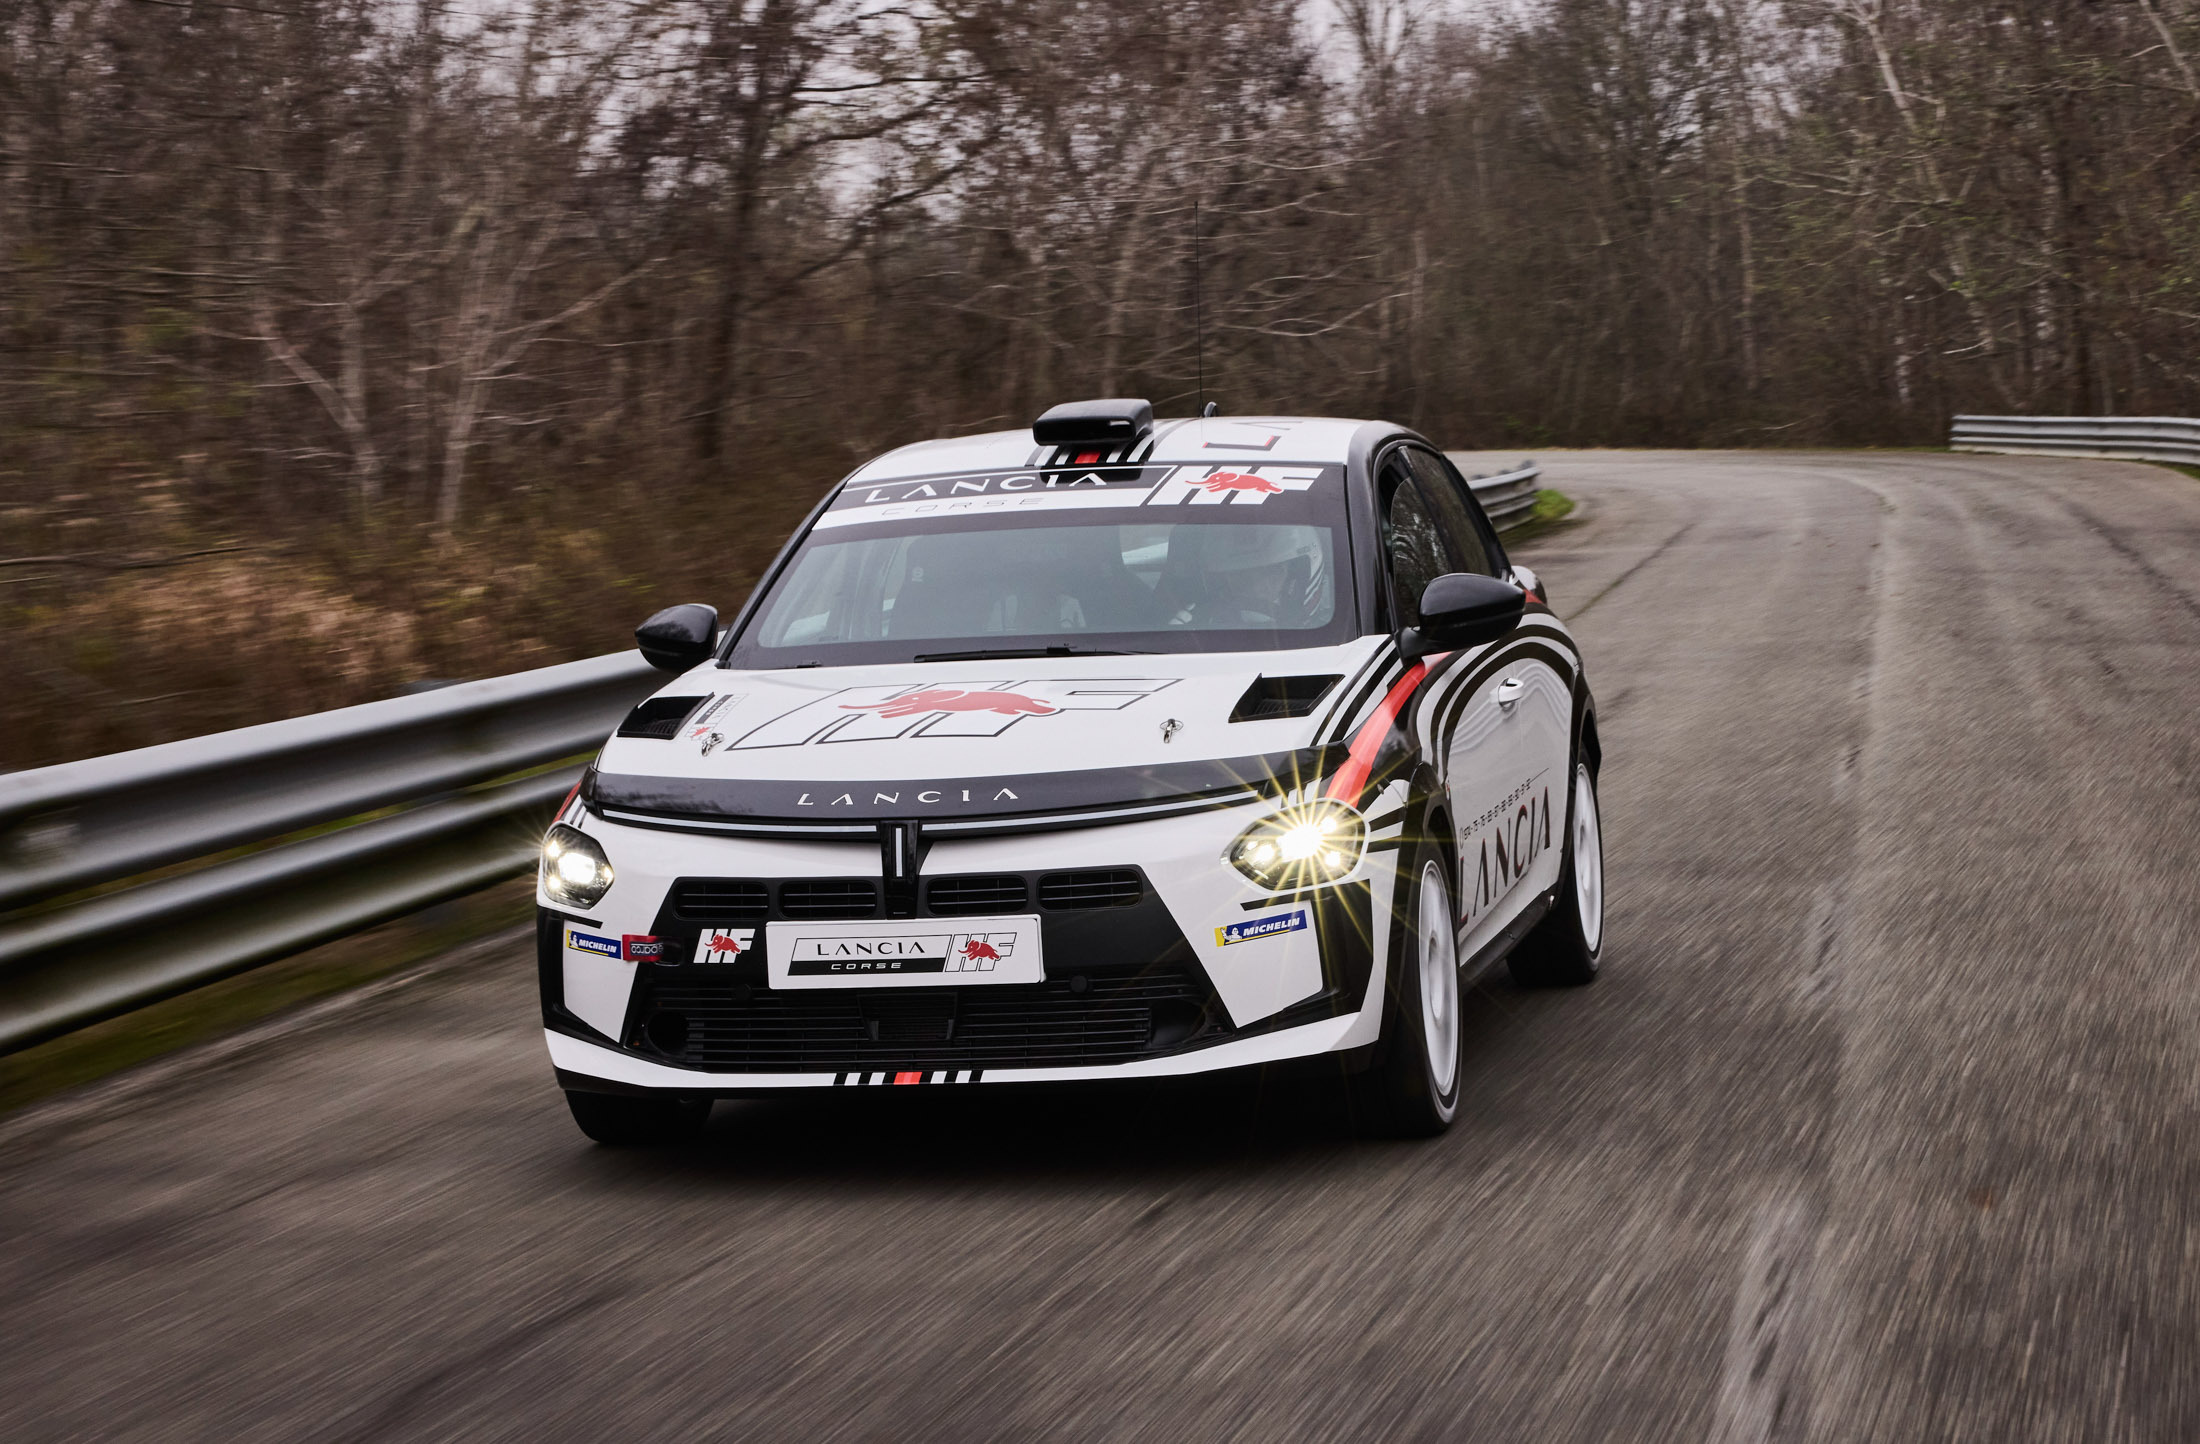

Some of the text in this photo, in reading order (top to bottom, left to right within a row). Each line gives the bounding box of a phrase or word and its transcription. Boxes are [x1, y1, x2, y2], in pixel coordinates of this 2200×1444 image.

[864, 472, 1108, 503] LANCIA
[1147, 465, 1325, 505] HF
[882, 497, 1046, 516] CORSE
[797, 787, 1019, 806] LANCIA
[1458, 786, 1551, 931] LANCIA
[1243, 917, 1300, 937] MICHELIN
[578, 938, 617, 954] MICHELIN
[693, 928, 756, 964] HF
[816, 941, 926, 956] LANCIA
[831, 962, 902, 971] CORSE
